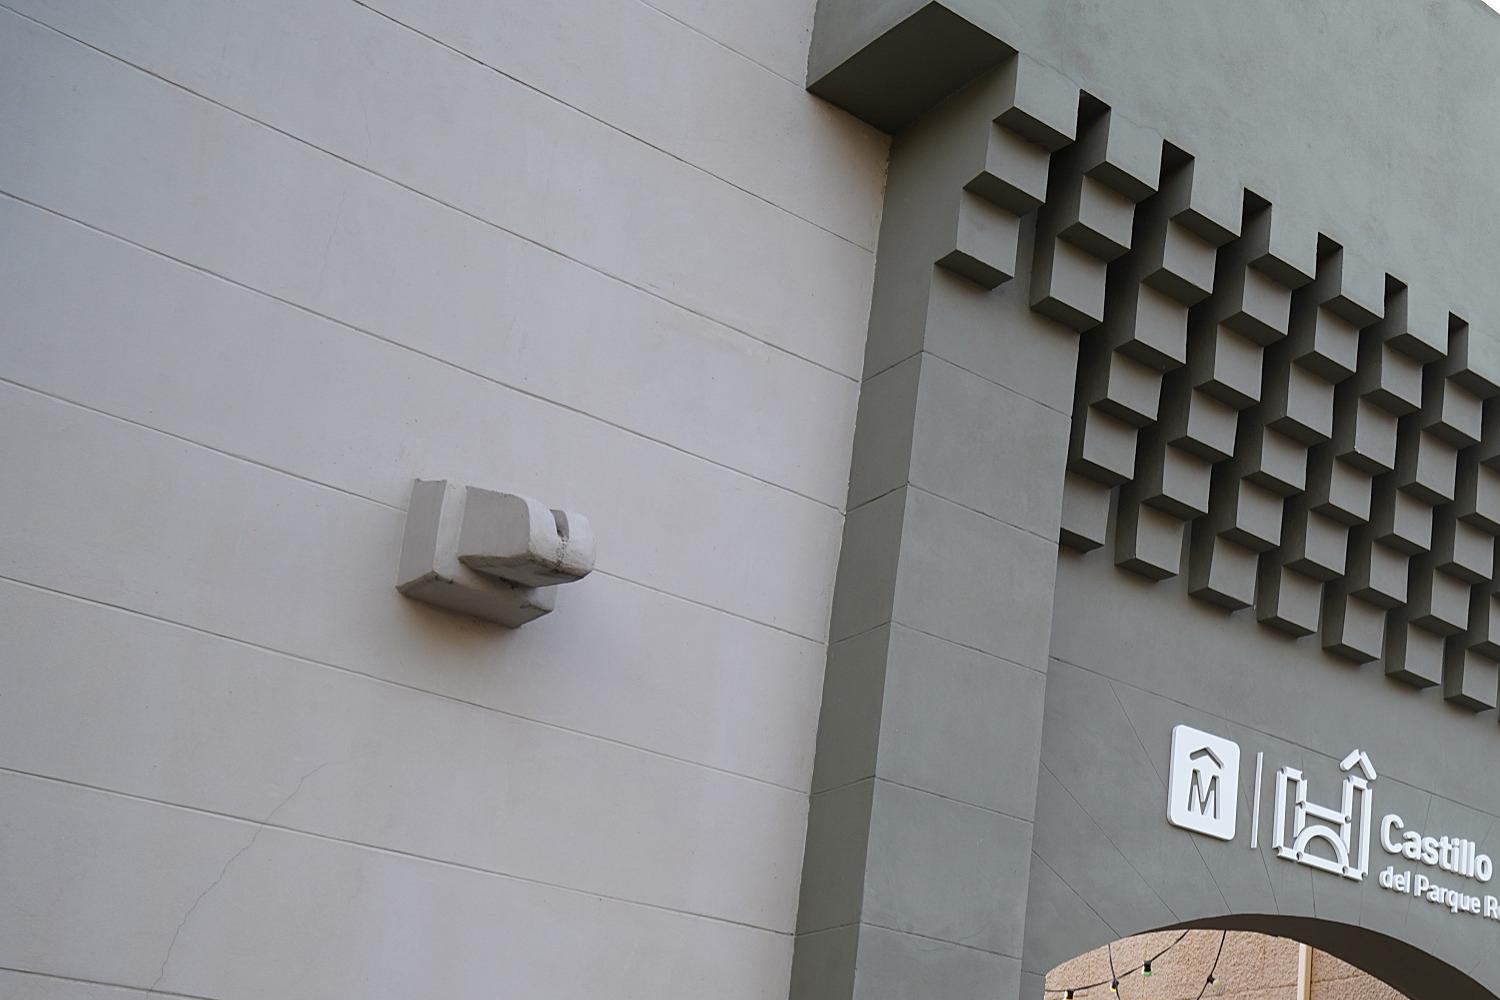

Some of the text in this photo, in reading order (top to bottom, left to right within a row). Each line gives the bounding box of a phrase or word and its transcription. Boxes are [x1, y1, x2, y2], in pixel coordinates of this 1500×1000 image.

[1187, 768, 1221, 820] M
[1380, 813, 1493, 883] Castillo
[1378, 865, 1411, 894] del
[1413, 873, 1481, 914] Parque
